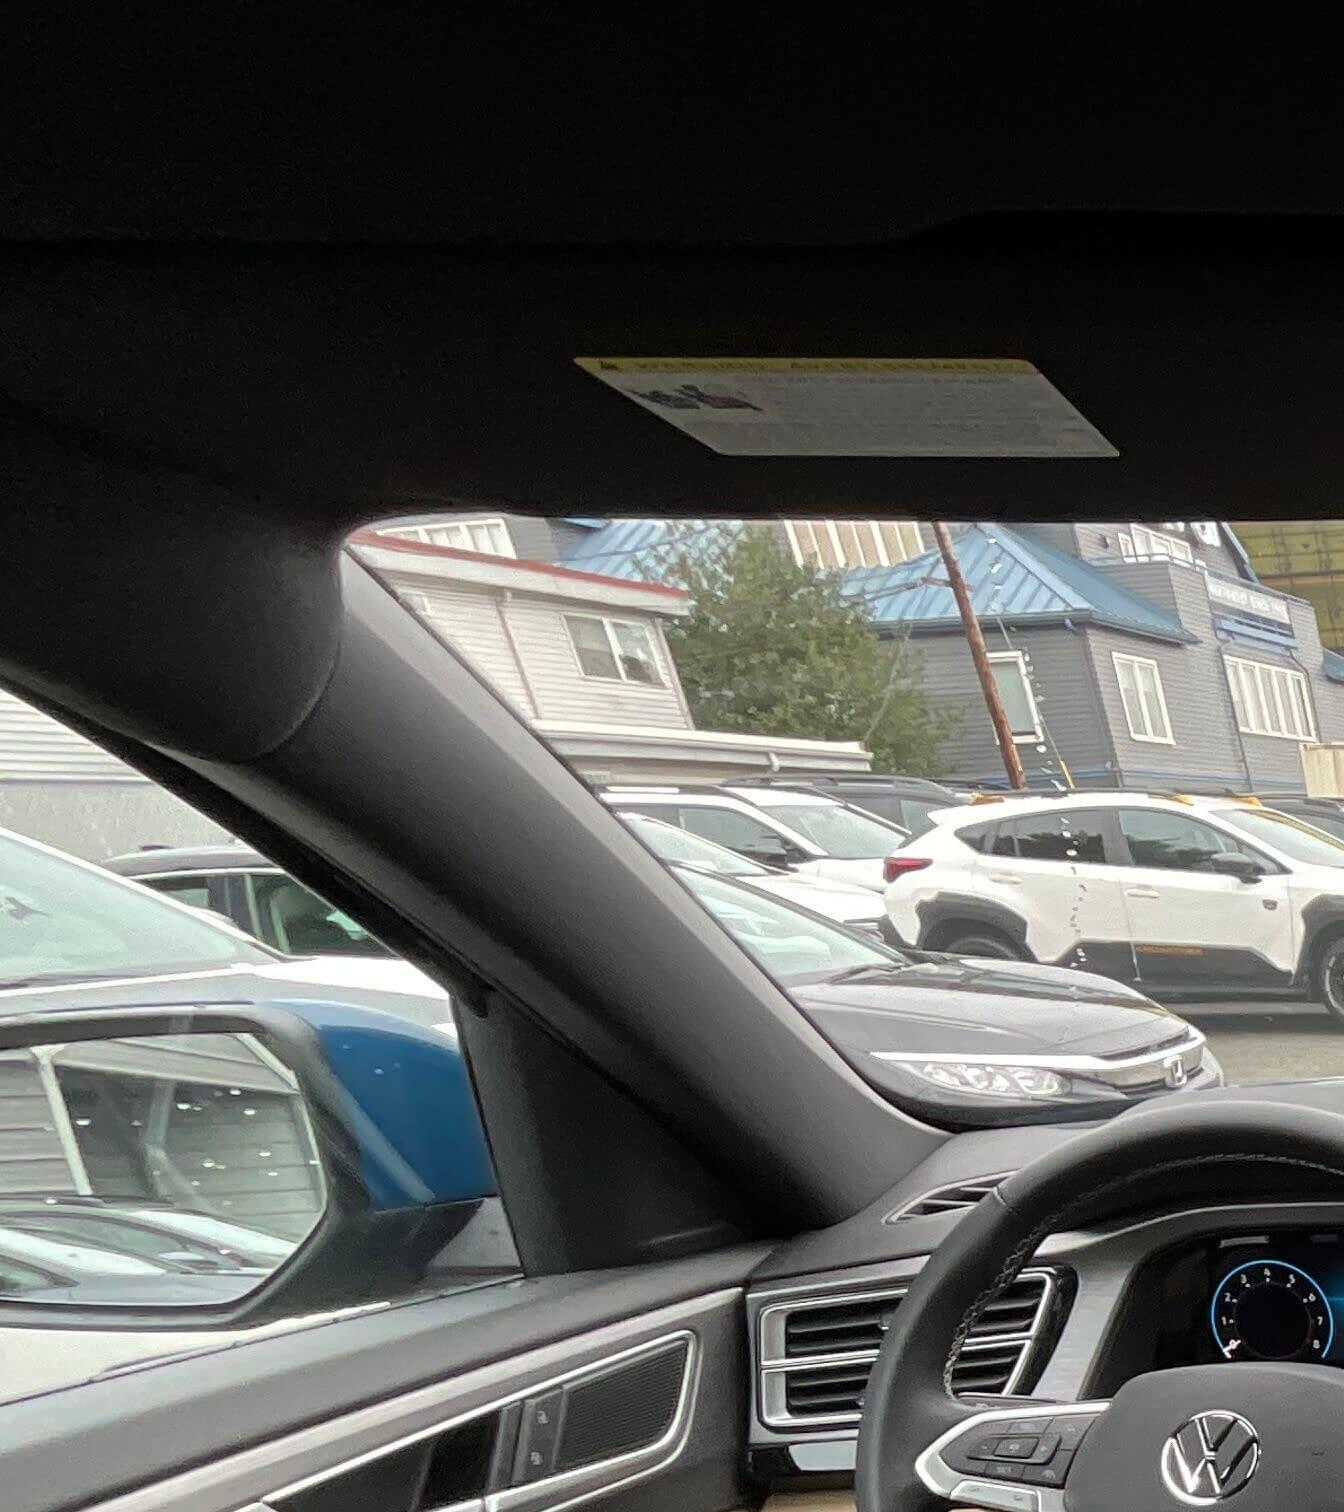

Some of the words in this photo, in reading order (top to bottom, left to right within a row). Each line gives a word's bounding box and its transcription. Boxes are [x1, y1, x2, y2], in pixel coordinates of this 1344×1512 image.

[1264, 1268, 1271, 1276] 4
[1241, 1274, 1247, 1284] 3
[1289, 1274, 1296, 1284] 5
[1224, 1293, 1231, 1302] 2
[1308, 1293, 1316, 1302] 6
[1222, 1316, 1227, 1325] 1
[1317, 1316, 1323, 1325] 7
[1312, 1339, 1320, 1349] 8
